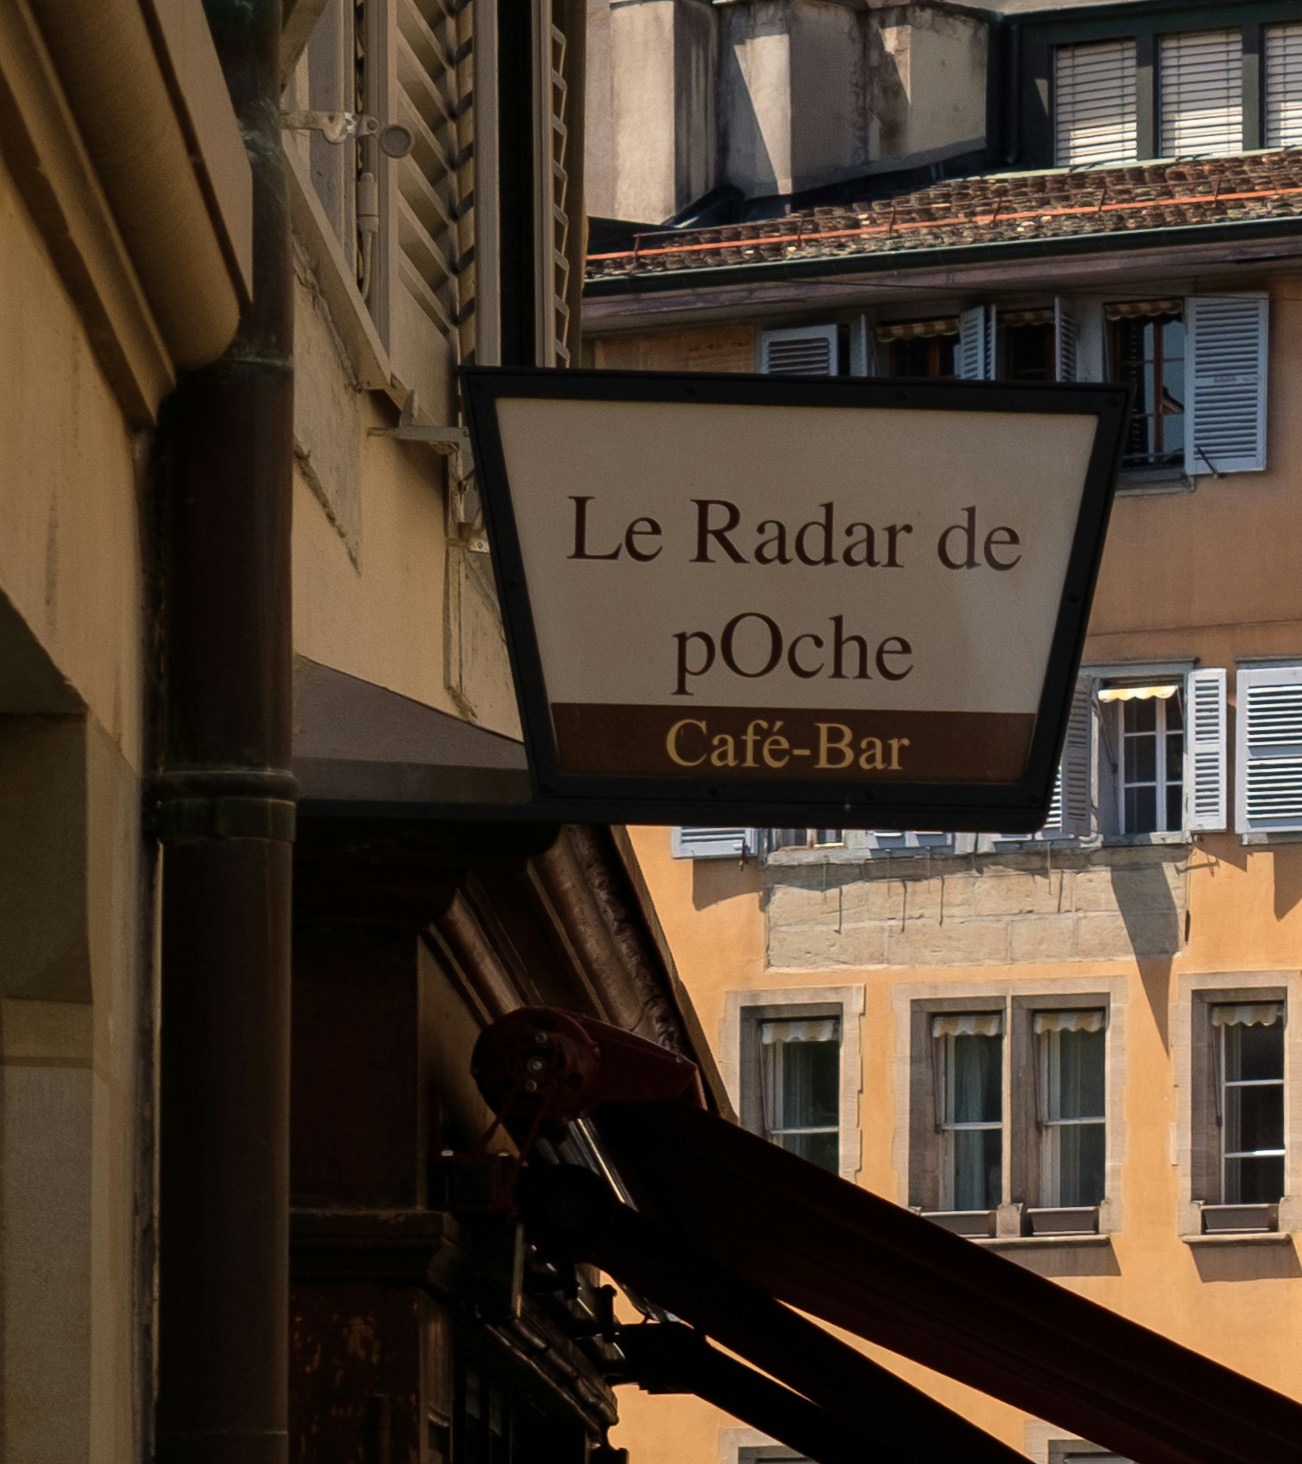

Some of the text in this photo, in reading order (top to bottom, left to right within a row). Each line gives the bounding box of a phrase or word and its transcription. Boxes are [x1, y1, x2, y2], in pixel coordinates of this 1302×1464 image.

[566, 494, 1022, 572] Le Radar de
[670, 610, 915, 696] pOche
[665, 717, 911, 772] Café-Bar
